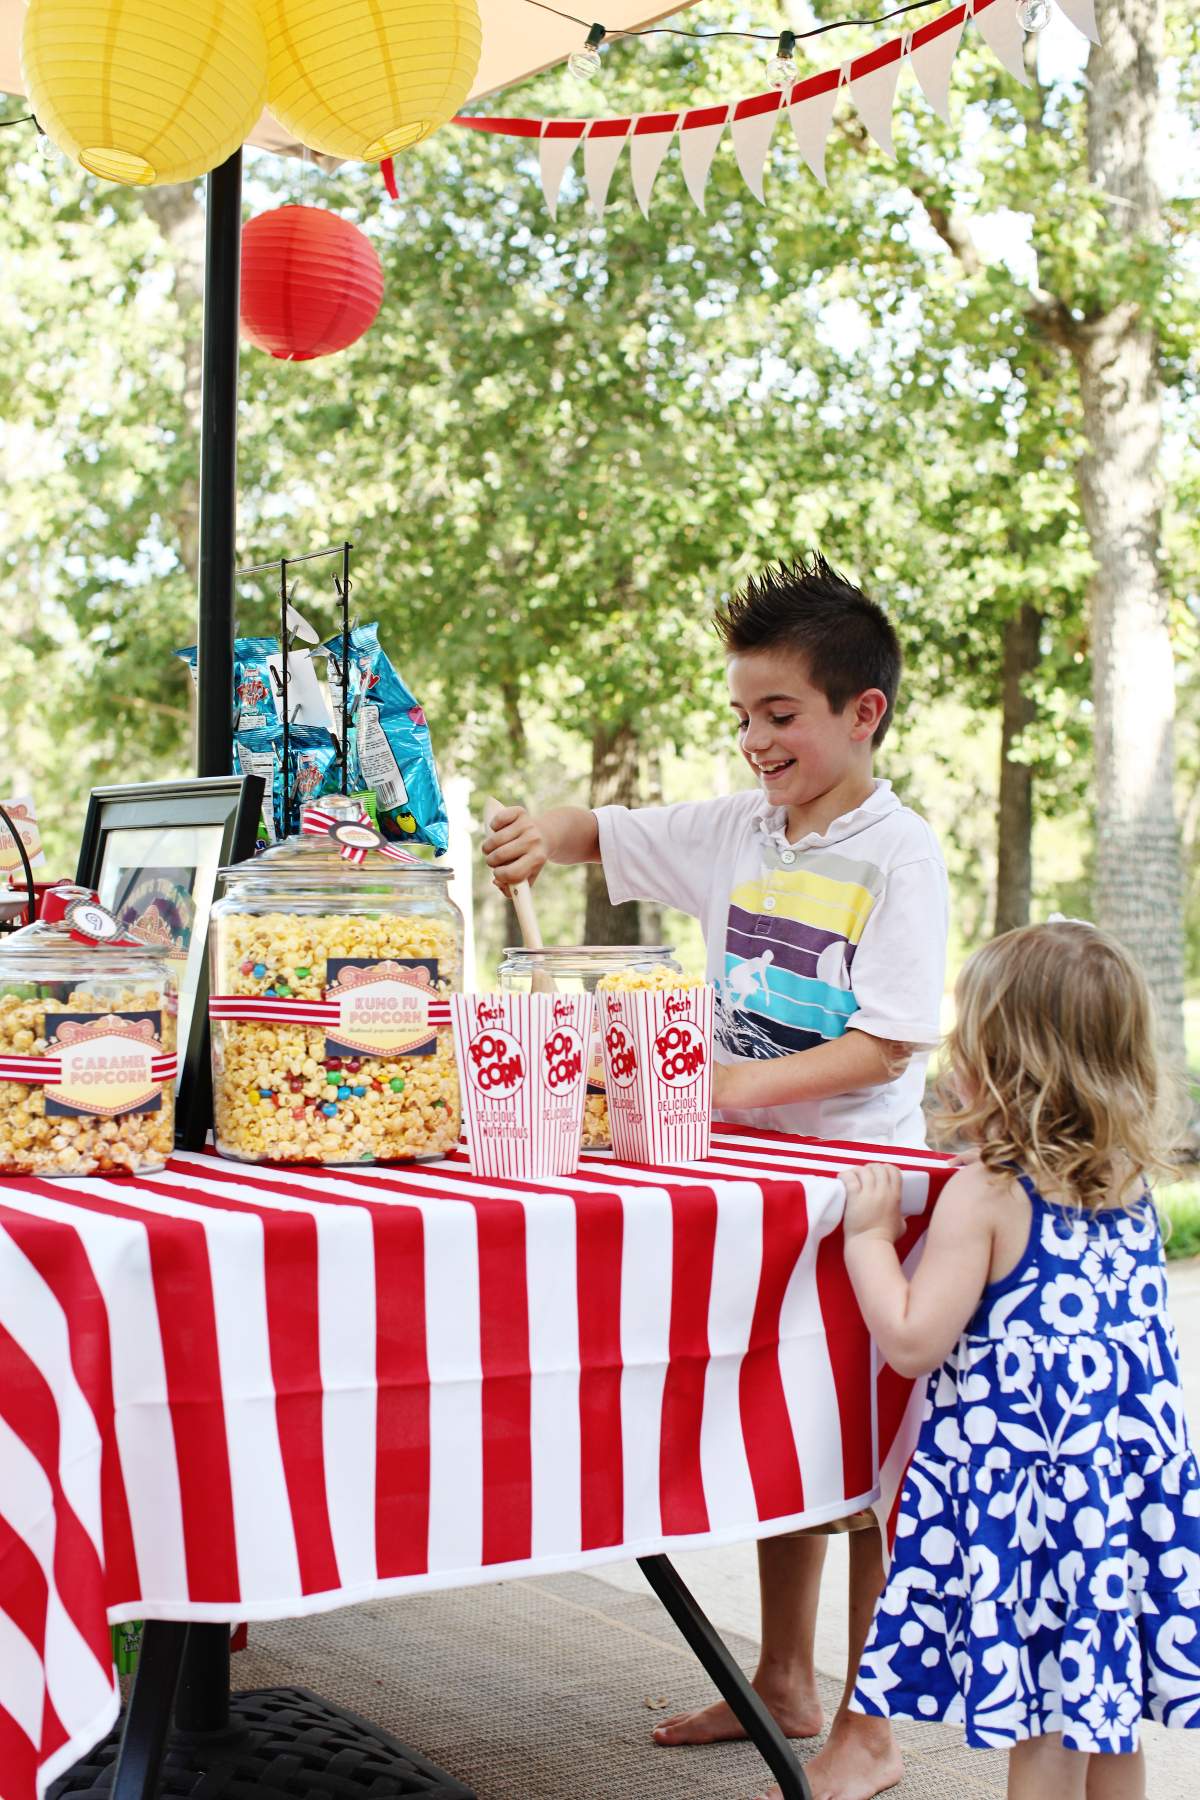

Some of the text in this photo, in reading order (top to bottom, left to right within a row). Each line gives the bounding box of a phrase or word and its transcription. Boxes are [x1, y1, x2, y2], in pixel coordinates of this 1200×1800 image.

[355, 997, 418, 1010] KUNG FU
[477, 1002, 505, 1028] fresh
[553, 1000, 574, 1025] fresh
[665, 996, 691, 1021] fresh
[349, 1010, 422, 1025] POPCORN
[469, 1035, 507, 1067] POP
[544, 1032, 573, 1065] POP
[606, 1027, 626, 1057] POP
[656, 1027, 691, 1060] POP
[477, 1054, 524, 1090] CORN
[548, 1050, 582, 1088] CORN
[611, 1046, 638, 1079] CORN
[662, 1042, 705, 1080] CORN
[70, 1069, 147, 1085] POPCORN
[476, 1110, 516, 1122] DELICIOUS
[658, 1097, 697, 1111] DELICIOUS
[663, 1111, 707, 1126] NUTRITIOUS
[483, 1126, 528, 1139] NUTRITIOUS
